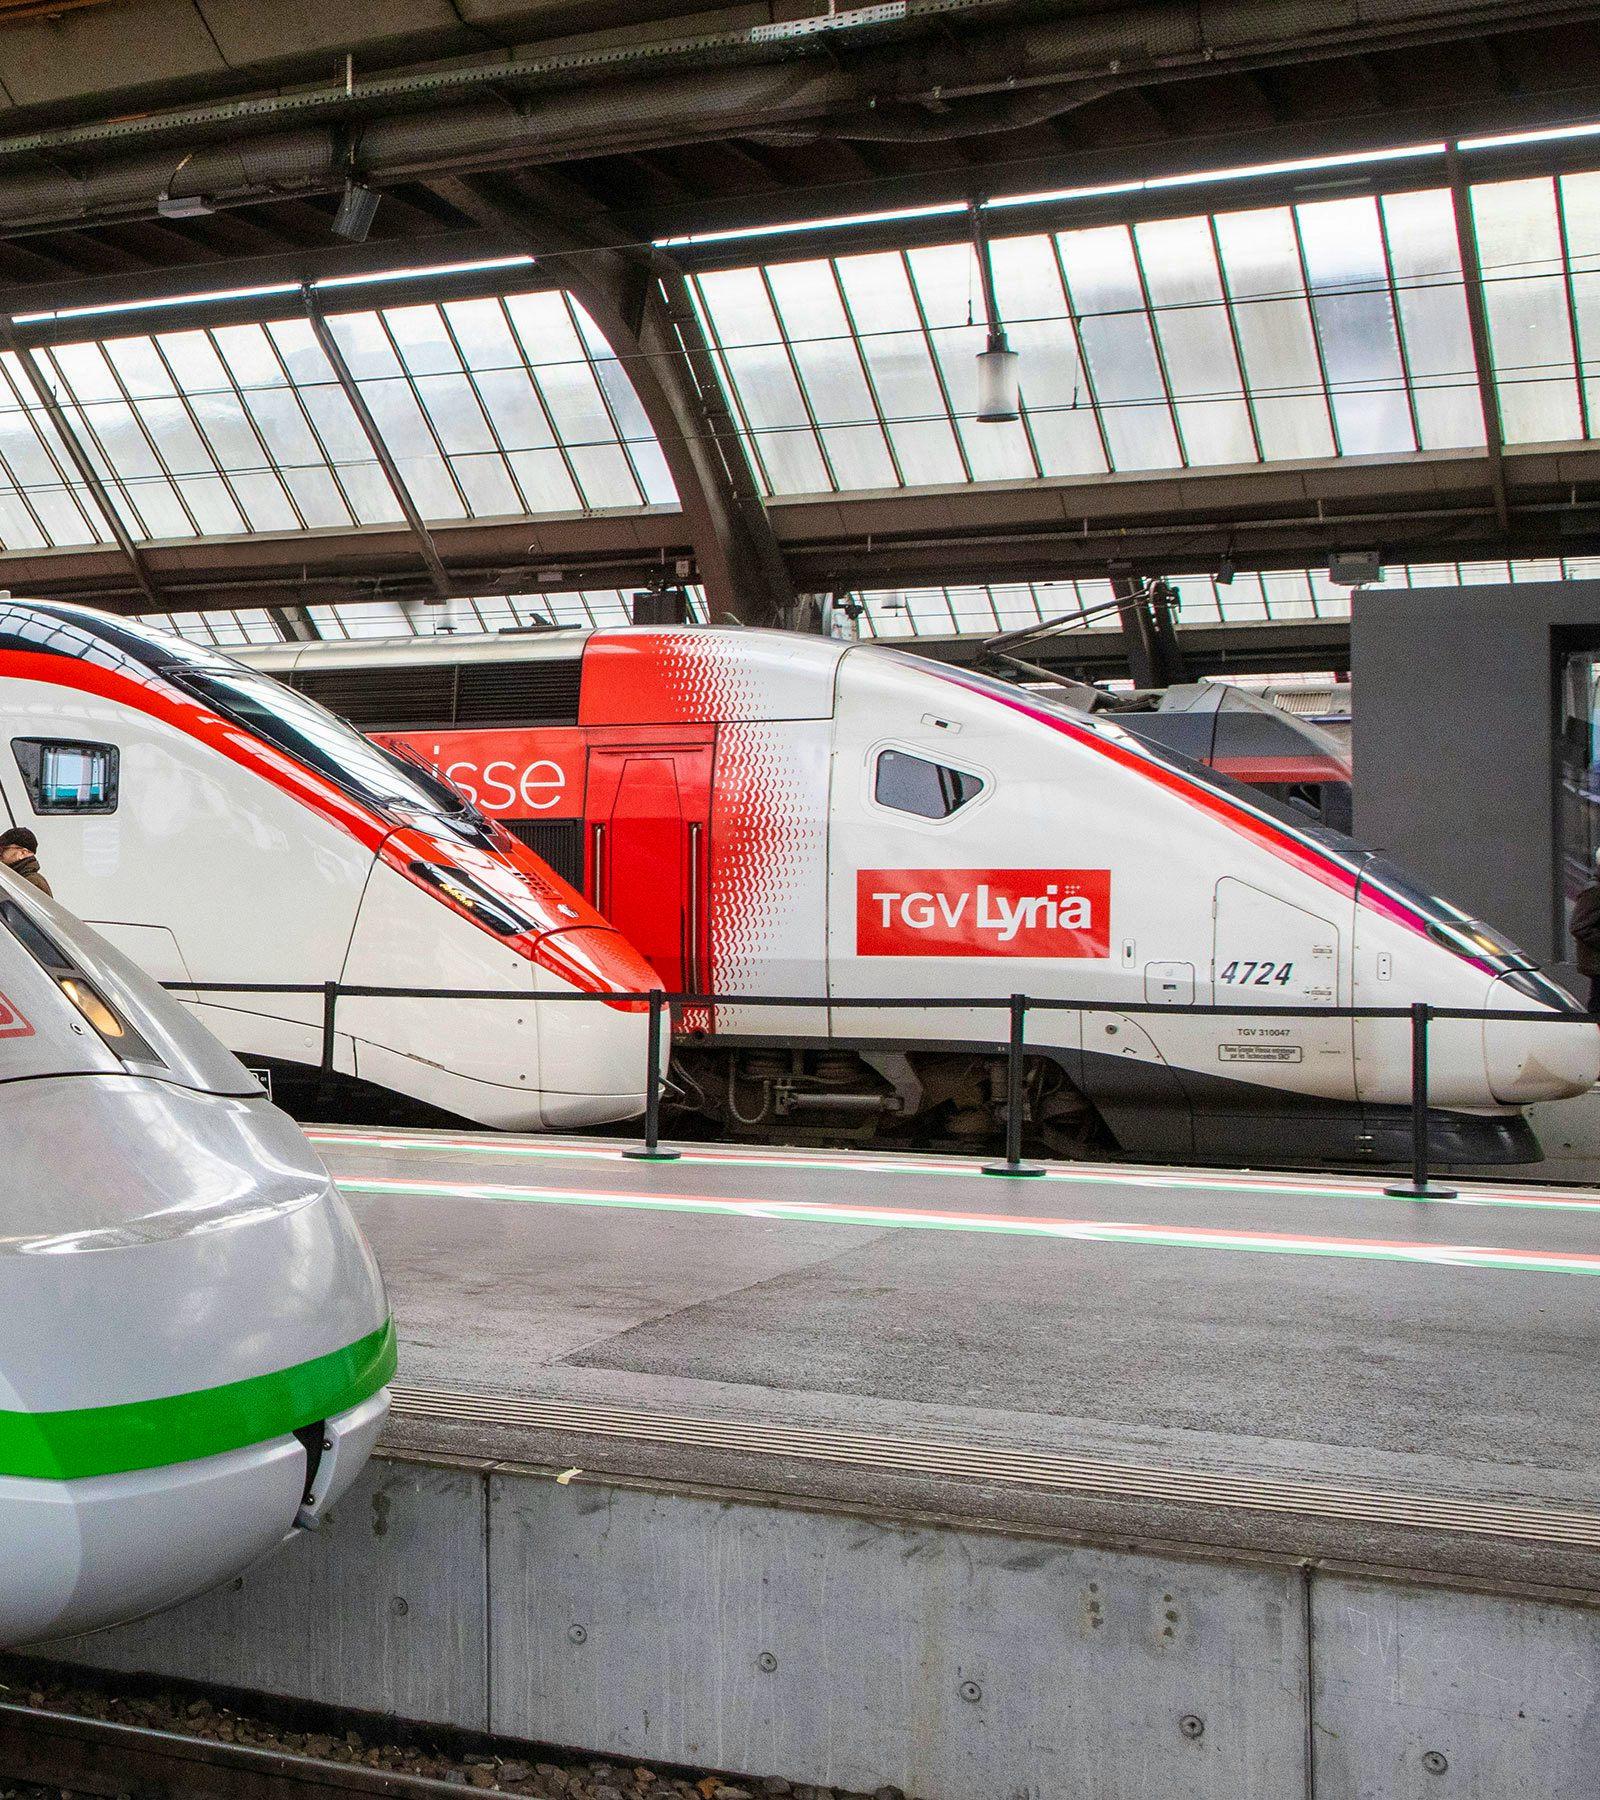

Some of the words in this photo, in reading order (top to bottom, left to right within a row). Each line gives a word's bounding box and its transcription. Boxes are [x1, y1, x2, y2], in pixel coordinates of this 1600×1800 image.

[872, 892, 970, 929] TGV
[977, 885, 1092, 941] Lyria
[1220, 961, 1293, 986] 4724
[1238, 1028, 1257, 1037] TGV
